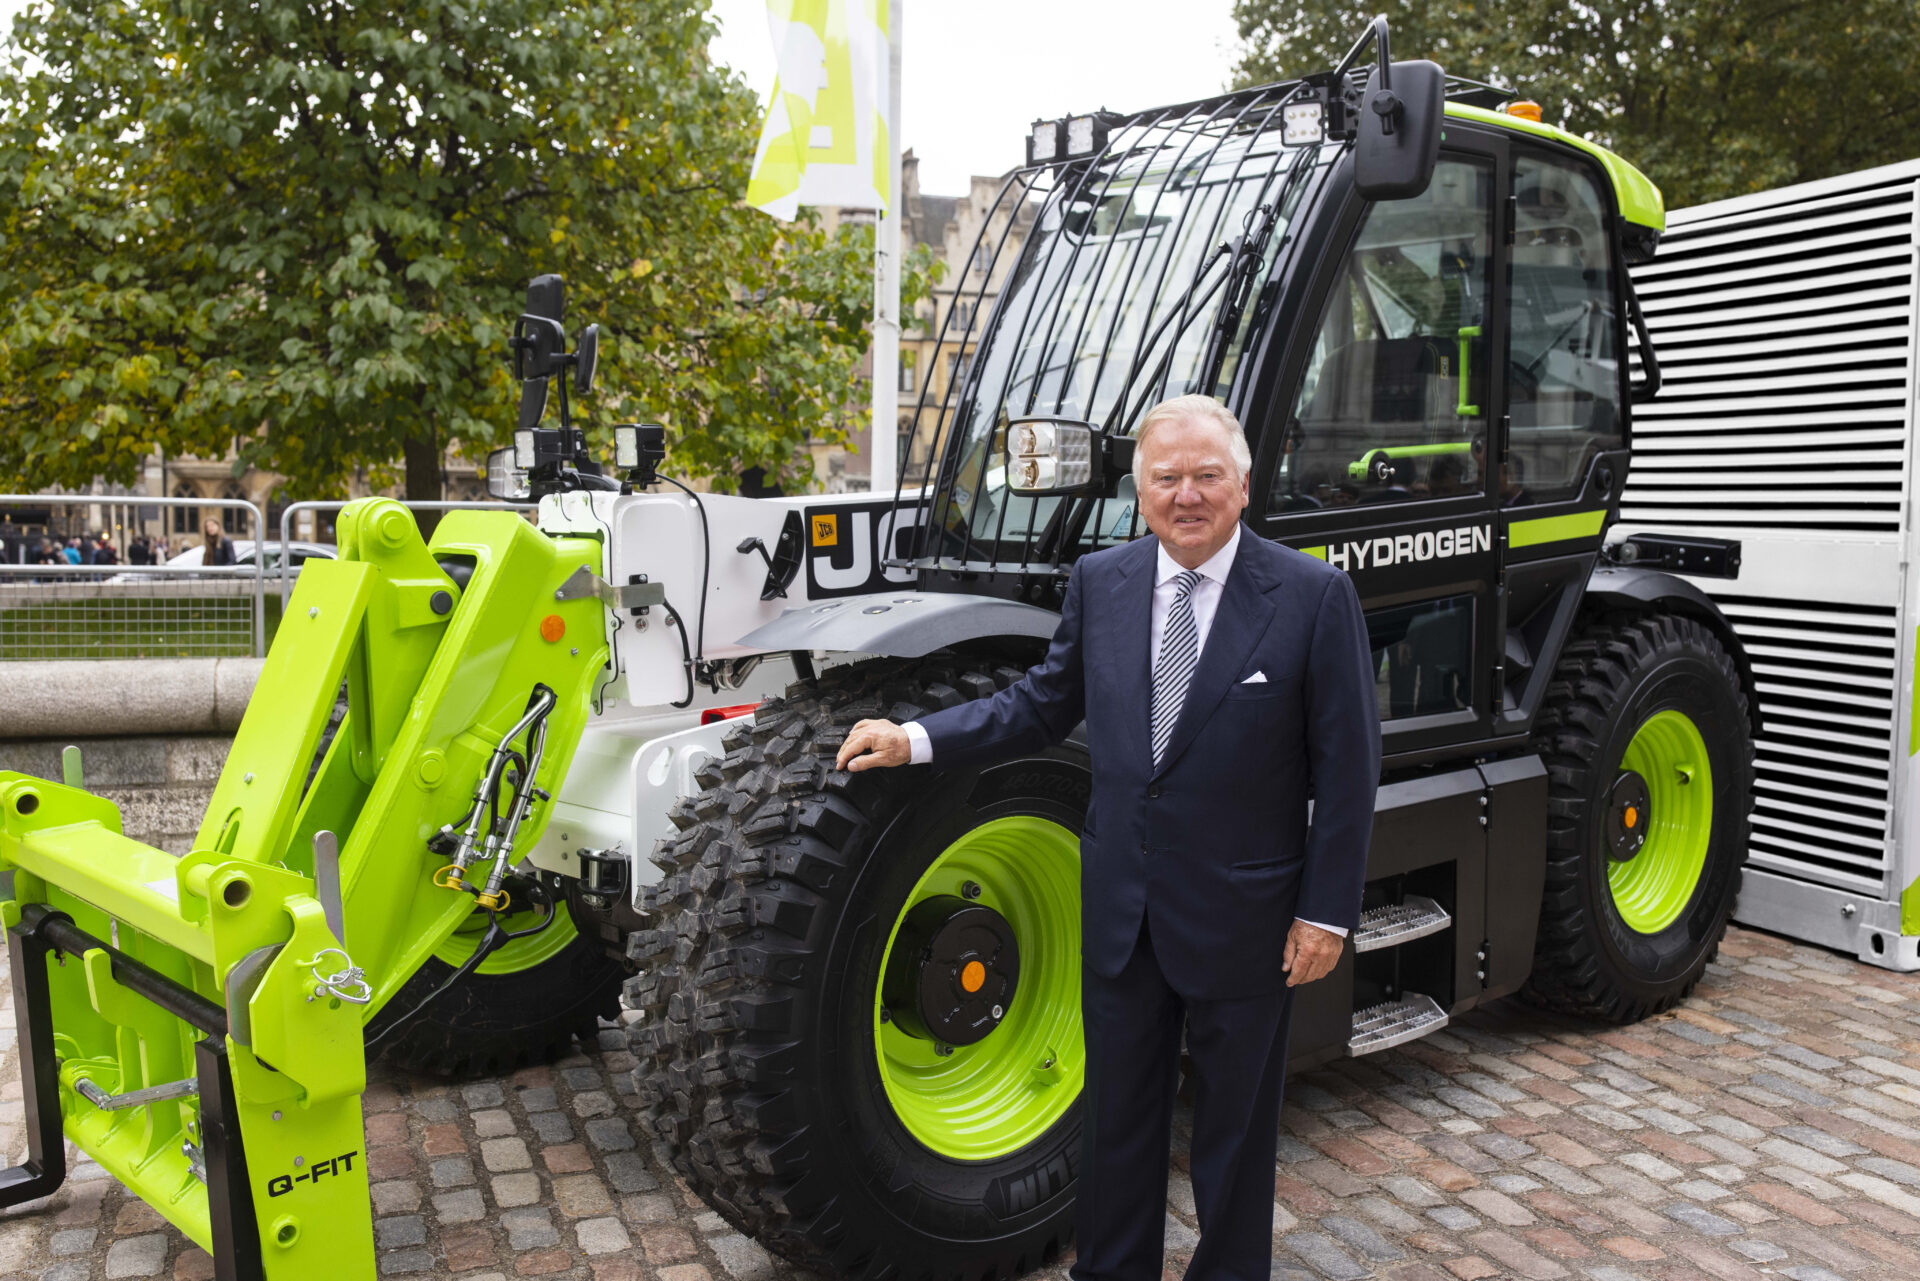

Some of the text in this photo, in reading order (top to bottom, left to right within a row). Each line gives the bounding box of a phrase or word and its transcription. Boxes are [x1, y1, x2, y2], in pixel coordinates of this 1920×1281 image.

[817, 522, 833, 538] JCB
[1328, 524, 1491, 571] HYDROGEN
[268, 1151, 358, 1198] Q-FIT
